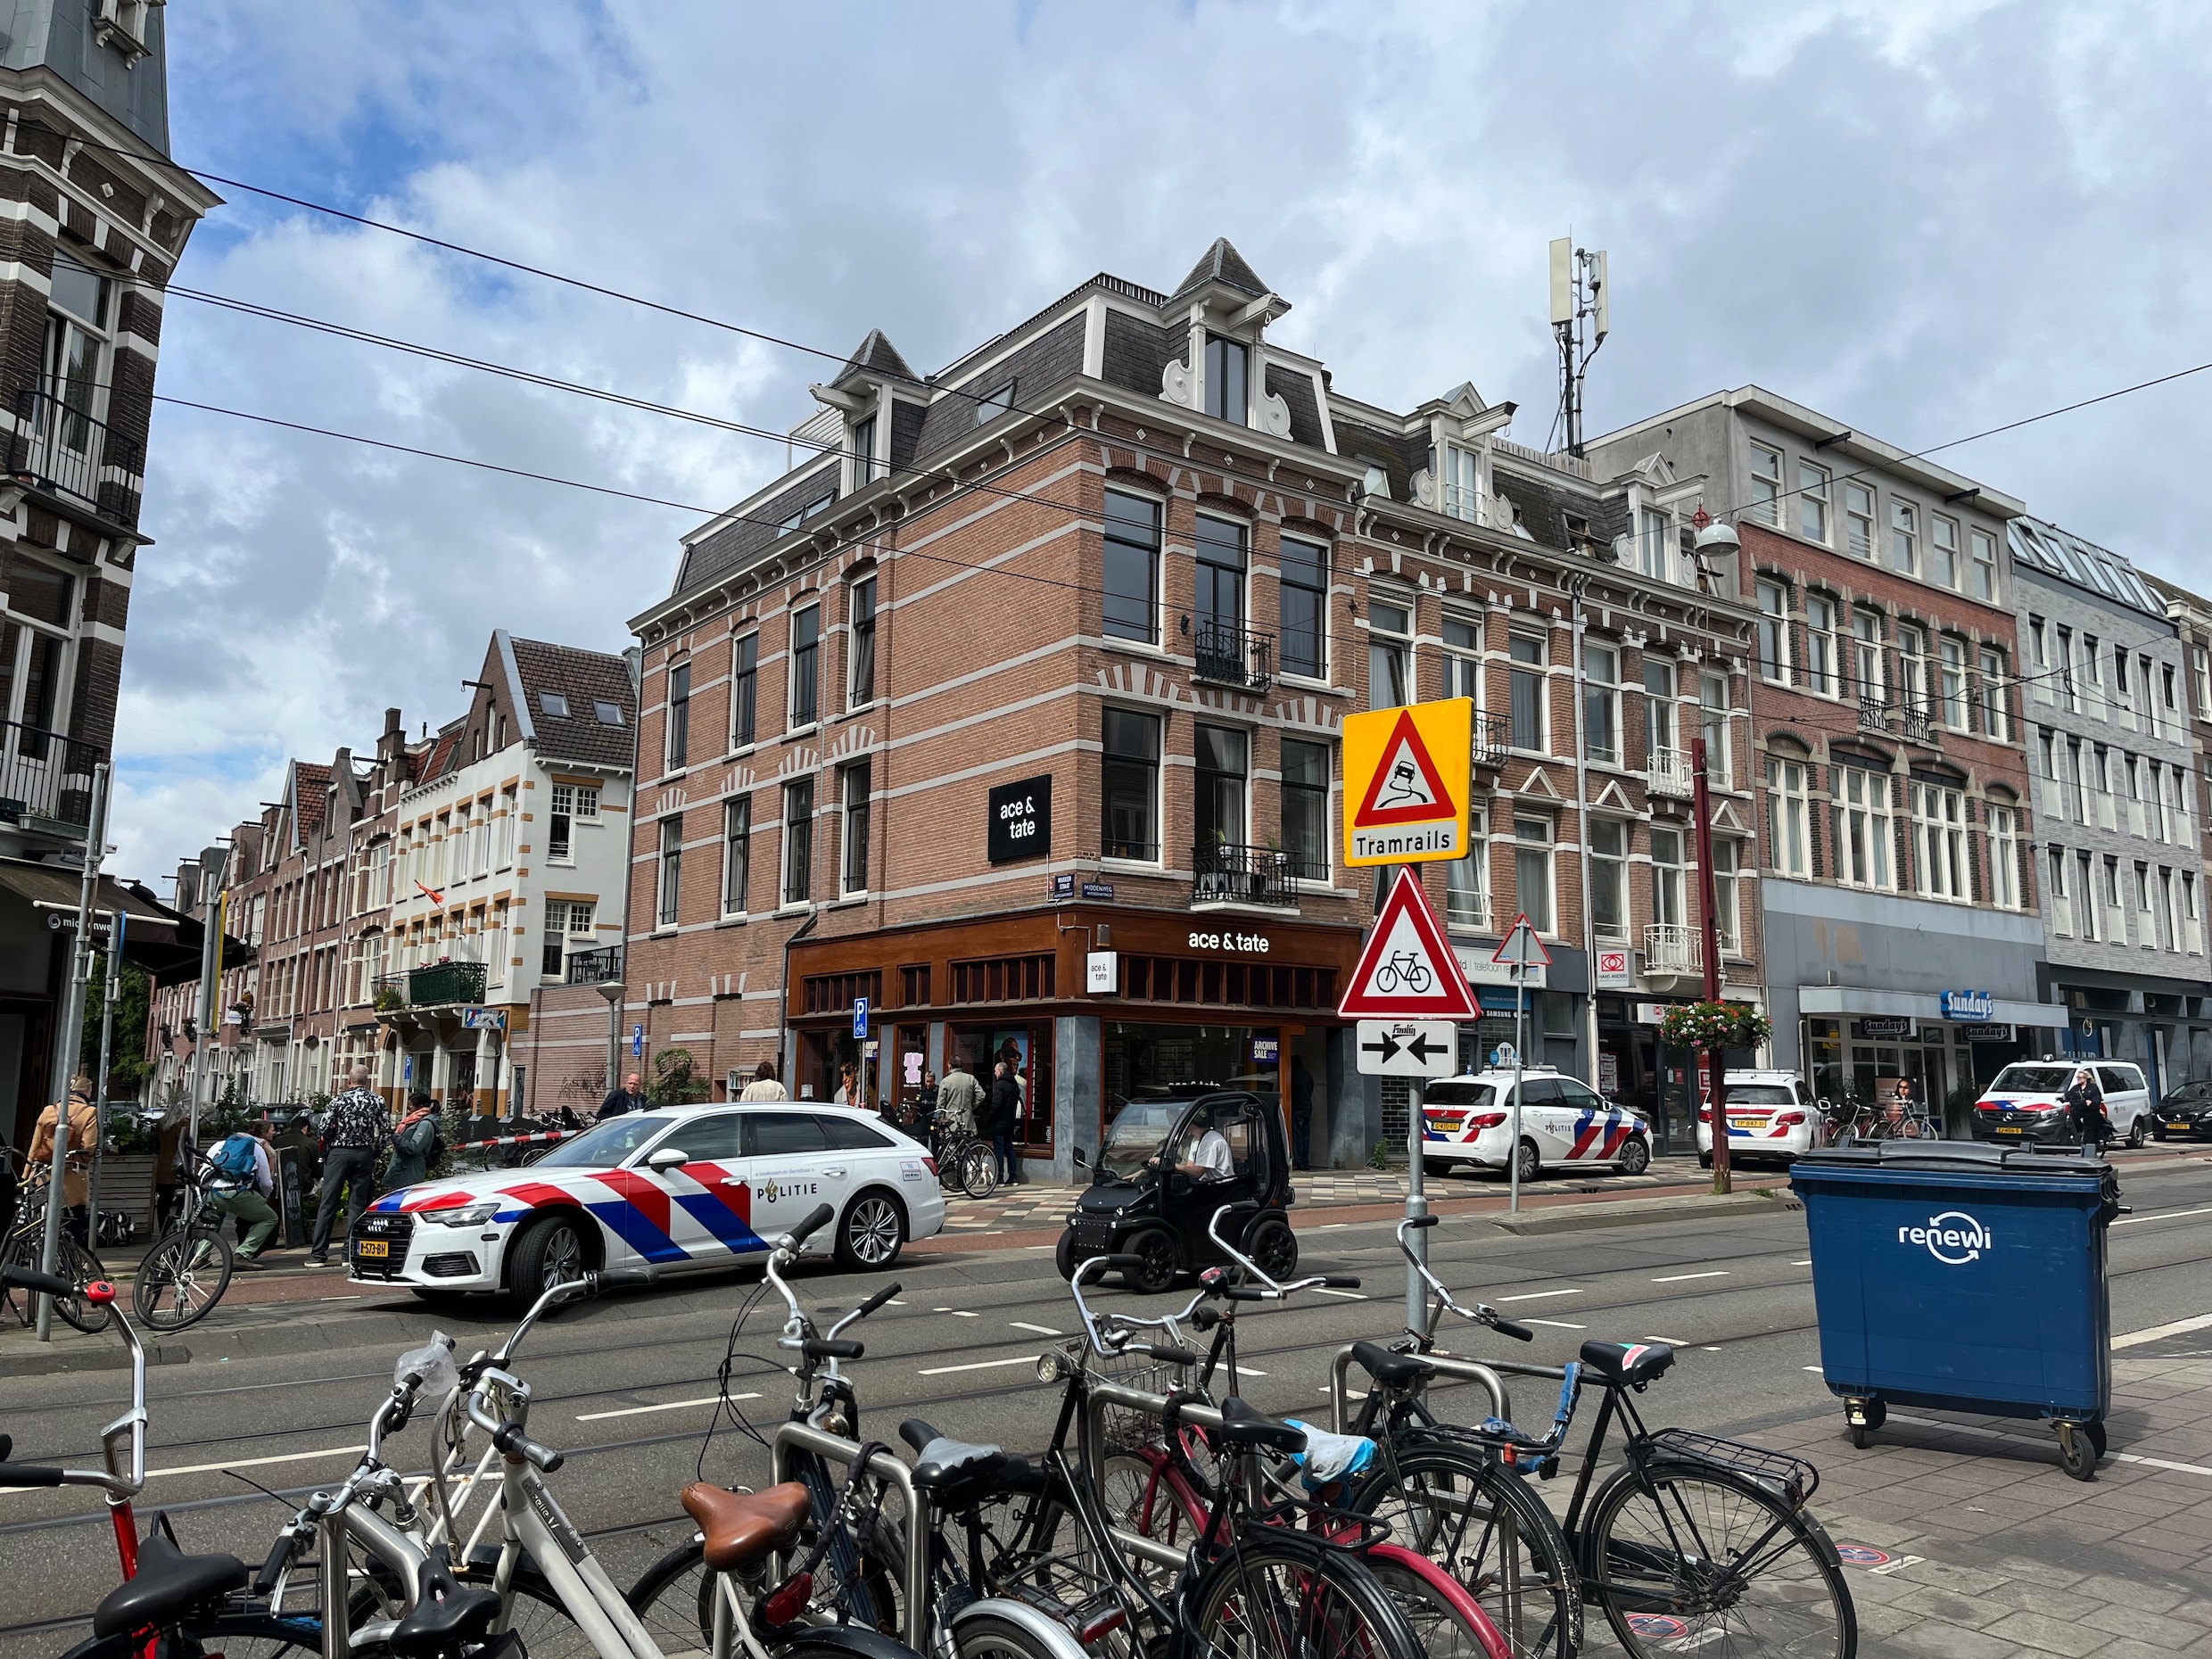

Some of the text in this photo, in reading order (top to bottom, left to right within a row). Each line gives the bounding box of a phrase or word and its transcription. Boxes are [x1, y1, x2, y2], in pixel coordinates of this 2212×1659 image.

[1000, 796, 1036, 820] ace &
[1009, 818, 1036, 838] tate
[1356, 830, 1450, 855] Tramrails
[1084, 884, 1113, 893] MIDDENWEG
[1188, 932, 1269, 953] ace & tate
[1091, 963, 1107, 972] ace &
[1473, 961, 1502, 973] telefoon
[1503, 964, 1511, 974] re
[1095, 972, 1107, 981] tate
[1948, 991, 1993, 1019] Sunday's
[1486, 1010, 1512, 1018] SAMSUNG
[1864, 1019, 1907, 1034] Sunday's
[1966, 1026, 2008, 1039] Sunday's
[1254, 1040, 1278, 1051] ARCHIVE
[1254, 1050, 1267, 1059] SALE
[757, 1183, 818, 1203] POLITIE
[1898, 1222, 1993, 1250] renewi
